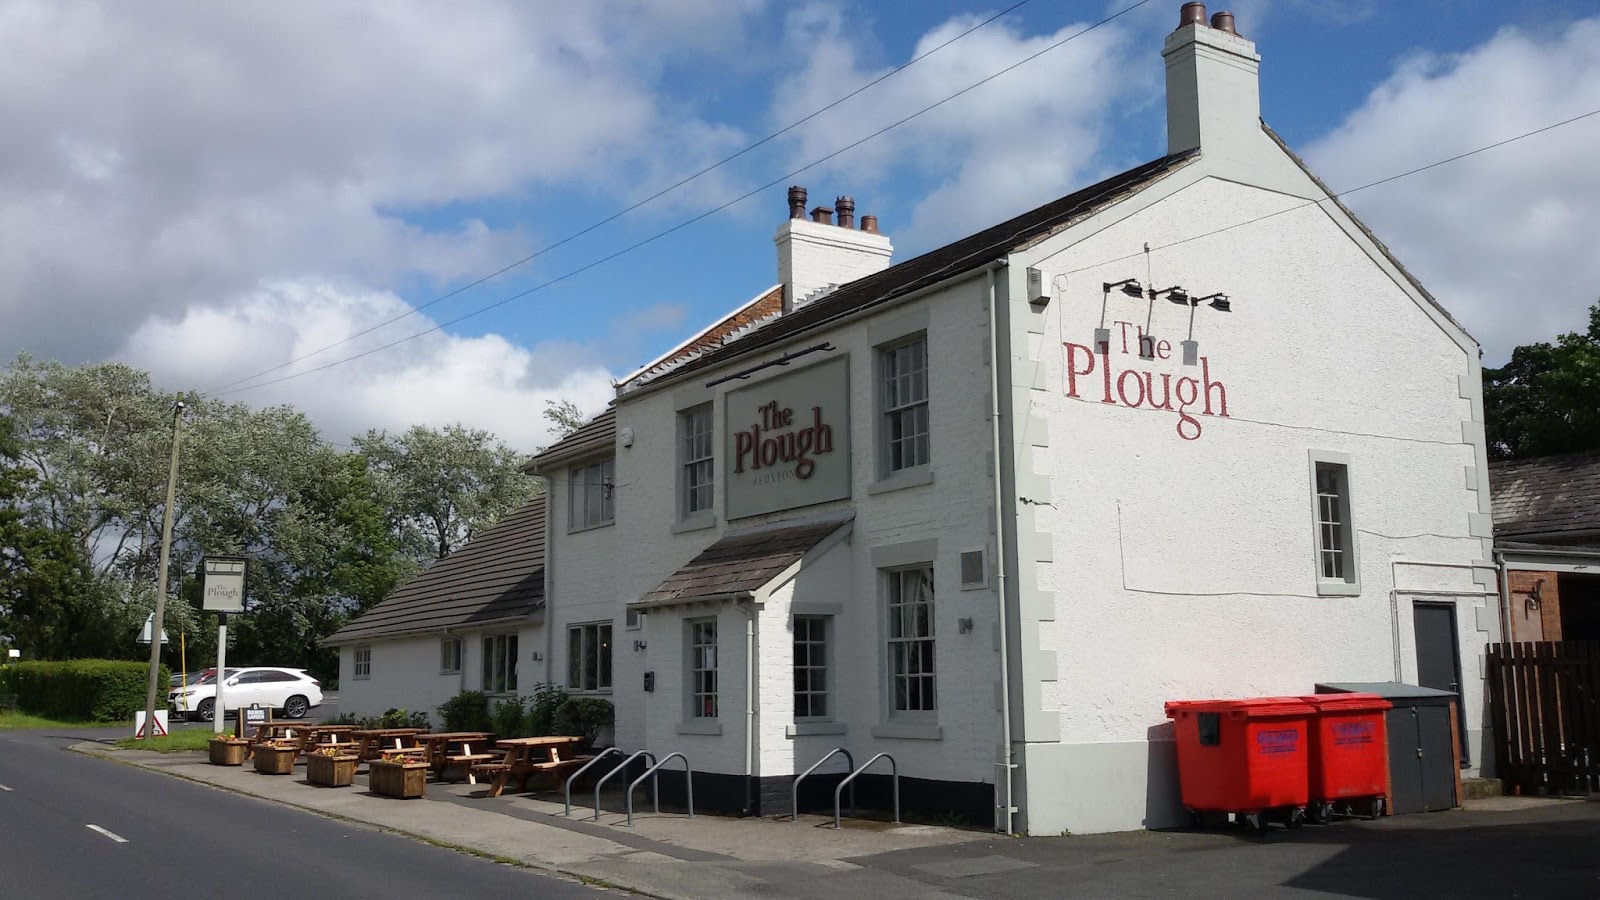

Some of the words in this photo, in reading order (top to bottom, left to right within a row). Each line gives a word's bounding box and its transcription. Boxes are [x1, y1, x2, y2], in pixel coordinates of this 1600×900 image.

[1114, 320, 1171, 359] The
[1063, 341, 1229, 440] Plough
[758, 400, 793, 432] The
[734, 406, 833, 480] Plough
[208, 588, 238, 599] Plough
